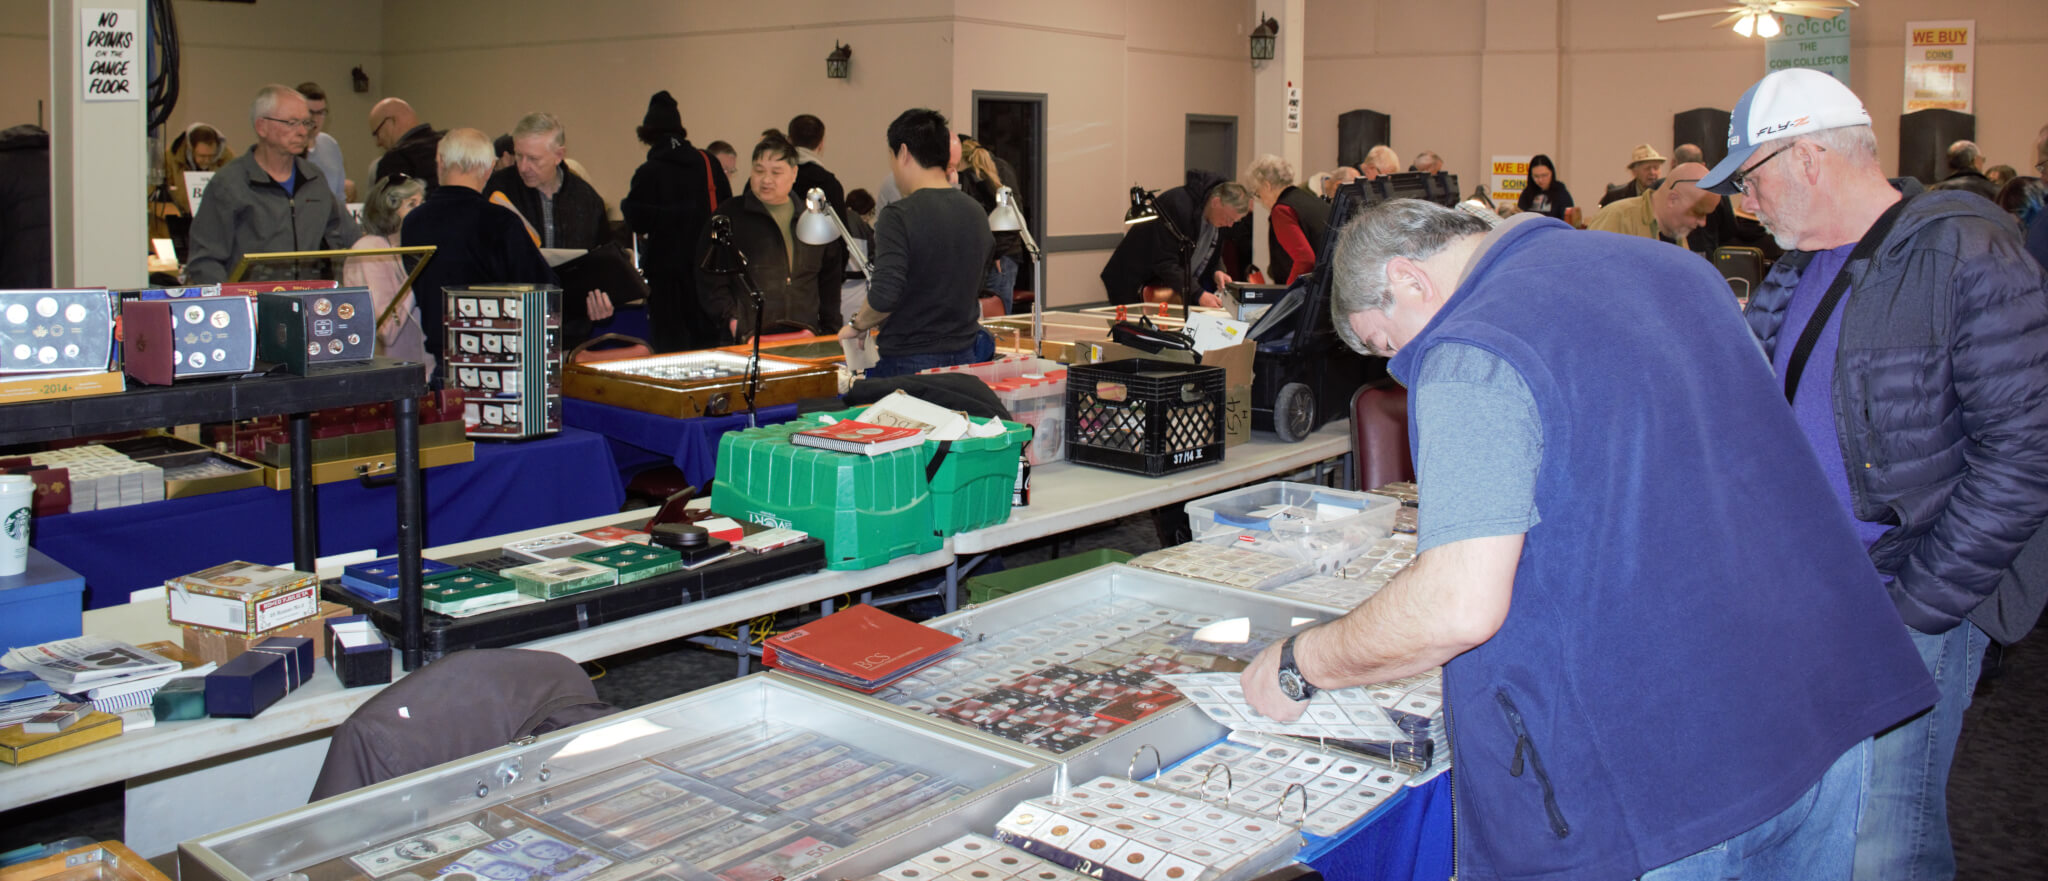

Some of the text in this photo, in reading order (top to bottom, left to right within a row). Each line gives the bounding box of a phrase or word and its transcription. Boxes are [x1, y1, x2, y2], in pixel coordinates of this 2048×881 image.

[98, 12, 118, 28] NO
[87, 30, 133, 48] DRINKS
[1912, 30, 1967, 43] WE BUY
[1799, 42, 1817, 51] THE
[1769, 55, 1849, 69] COIN COLLECTOR
[1926, 50, 1953, 60] COINS
[89, 60, 130, 76] DANCE
[89, 78, 130, 94] FLOOR
[1494, 162, 1512, 173] WE
[1502, 180, 1527, 189] COIN
[853, 652, 890, 669] BCS
[492, 840, 516, 853] 10
[805, 843, 835, 859] 50
